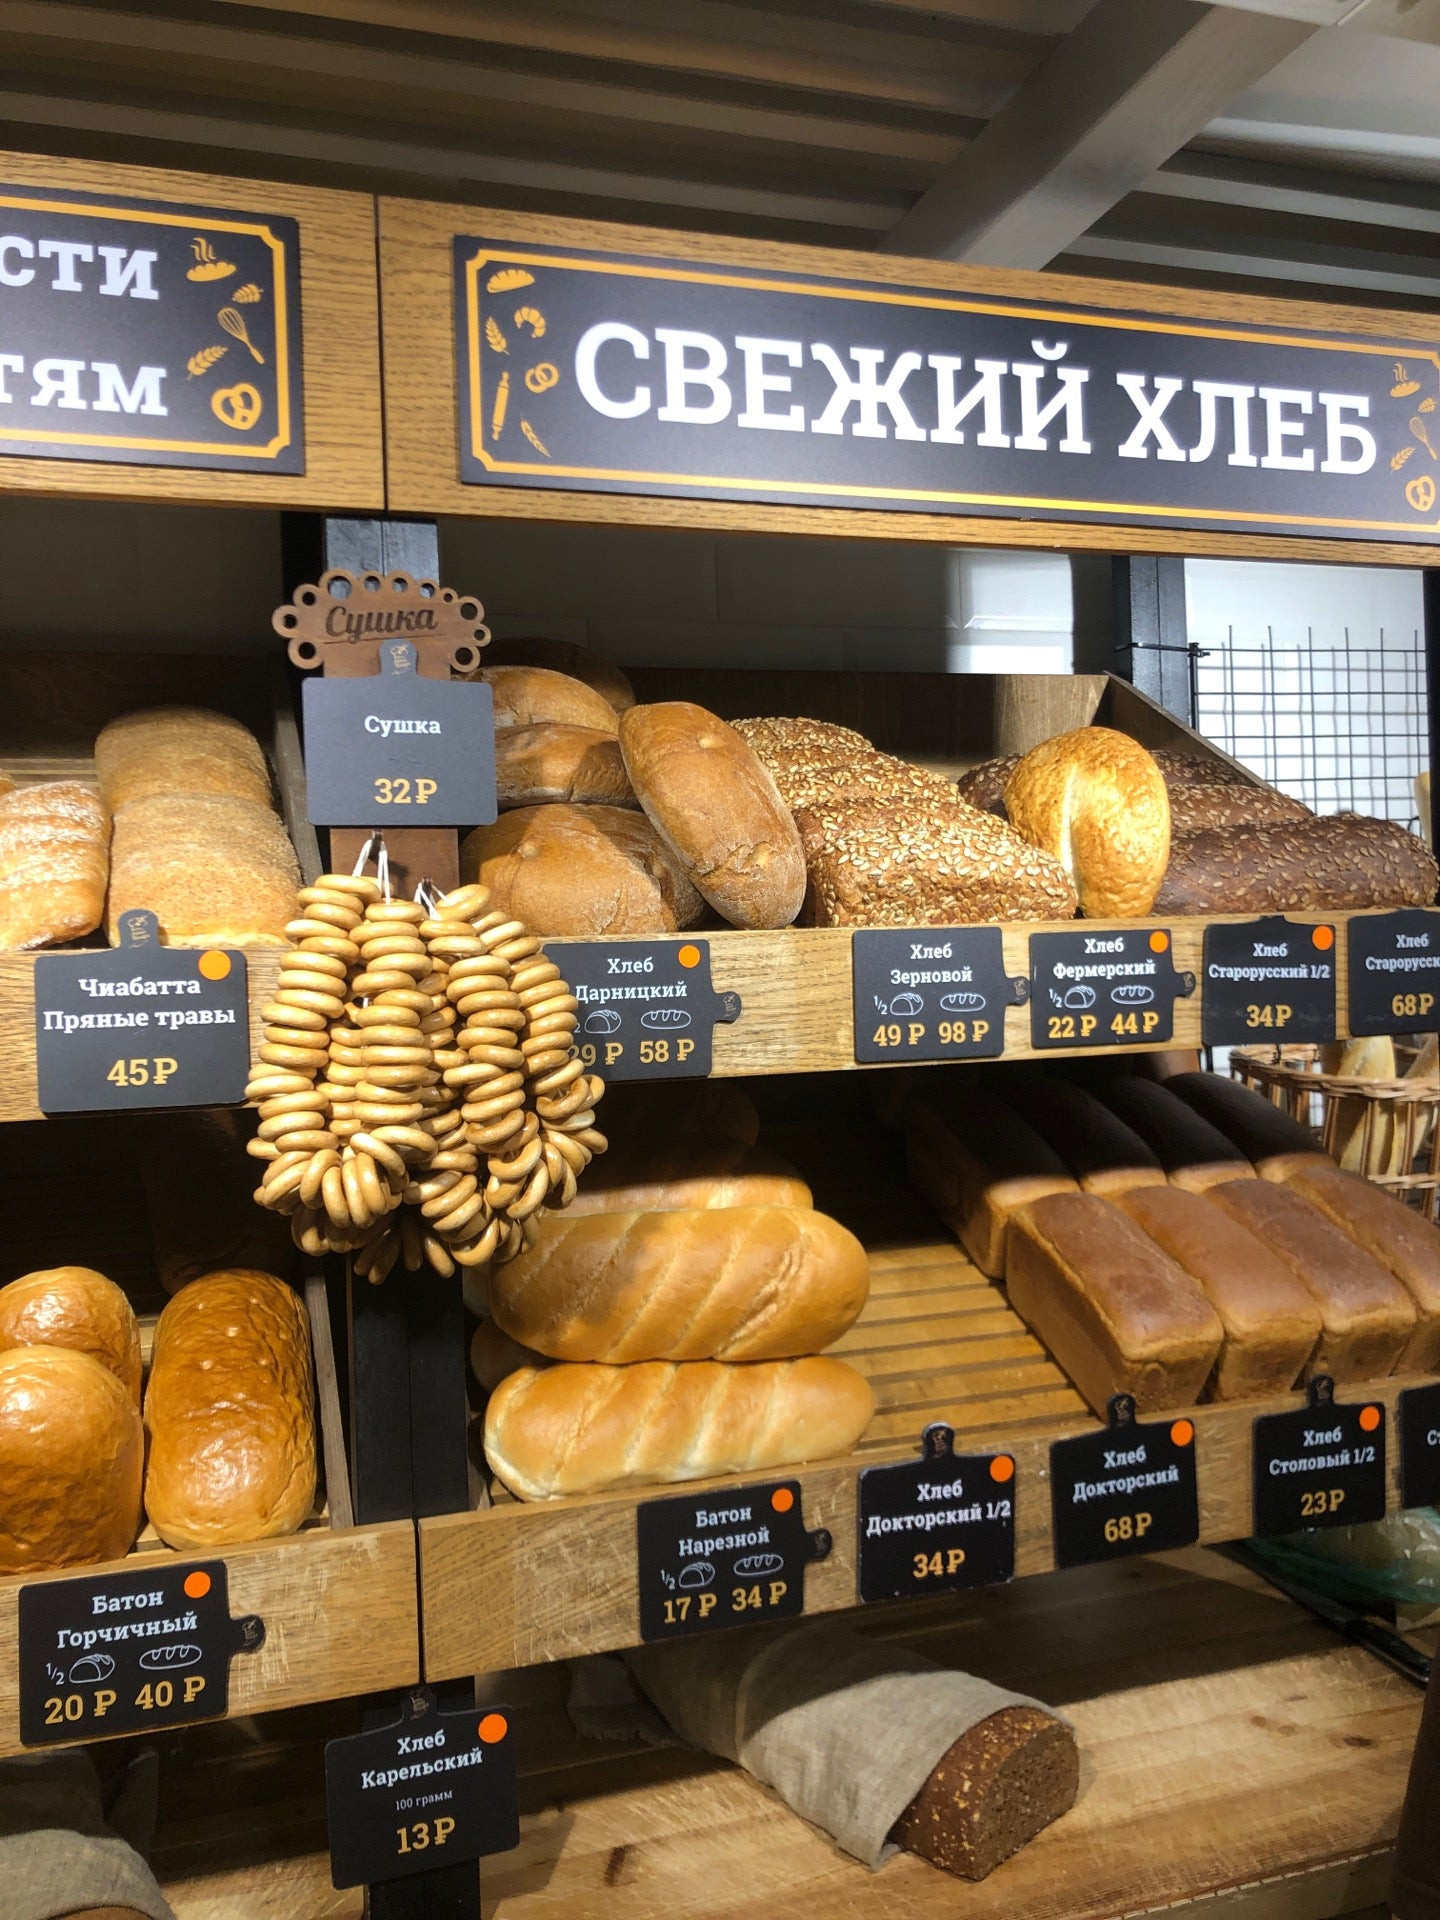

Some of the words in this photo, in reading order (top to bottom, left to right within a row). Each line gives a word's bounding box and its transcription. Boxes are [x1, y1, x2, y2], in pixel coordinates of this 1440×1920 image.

[573, 321, 1091, 454] СВЕЖИЙ
[1116, 372, 1378, 476] ХЛЕБ
[325, 606, 438, 644] Сушка
[364, 715, 442, 737] Сушка
[910, 943, 953, 960] Хлеб
[1084, 937, 1124, 954] Хлеб
[1252, 942, 1288, 958] Хлеб
[1395, 932, 1429, 949] Хлеб
[607, 956, 654, 974] Хлеб
[890, 966, 973, 987] Зерновой
[1052, 959, 1156, 981] Фермерский
[1208, 963, 1309, 981] Старорусский
[1310, 964, 1331, 979] 1/2
[78, 977, 201, 997] Чиабатта
[575, 980, 688, 1004] Дарницкий
[43, 1011, 149, 1034] Пряные
[154, 1009, 236, 1030] травы
[1048, 1016, 1075, 1039] 22
[1110, 1012, 1138, 1035] 44
[872, 1024, 901, 1047] 49
[938, 1021, 966, 1044] 98
[639, 1040, 669, 1064] 58
[1303, 1425, 1342, 1447] Хлеб
[1103, 1444, 1147, 1469] Хлеб
[1269, 1449, 1350, 1476] Столовый
[1353, 1446, 1375, 1465] 1/2
[917, 1478, 963, 1501] Хлеб
[1072, 1464, 1179, 1504] Докторский
[695, 1507, 752, 1528] Батон
[866, 1503, 982, 1538] Докторский
[986, 1500, 1011, 1520] 1/2
[678, 1526, 770, 1557] Нарезной
[91, 1591, 164, 1614] Батон
[663, 1596, 691, 1623] 17
[731, 1585, 762, 1611] 34
[56, 1611, 198, 1649] Горчичный
[44, 1695, 84, 1725] 20
[134, 1681, 173, 1710] 40
[397, 1729, 446, 1755] Хлеб
[361, 1747, 483, 1789] Карельский
[395, 1799, 413, 1811] 100
[416, 1790, 453, 1807] грамм
